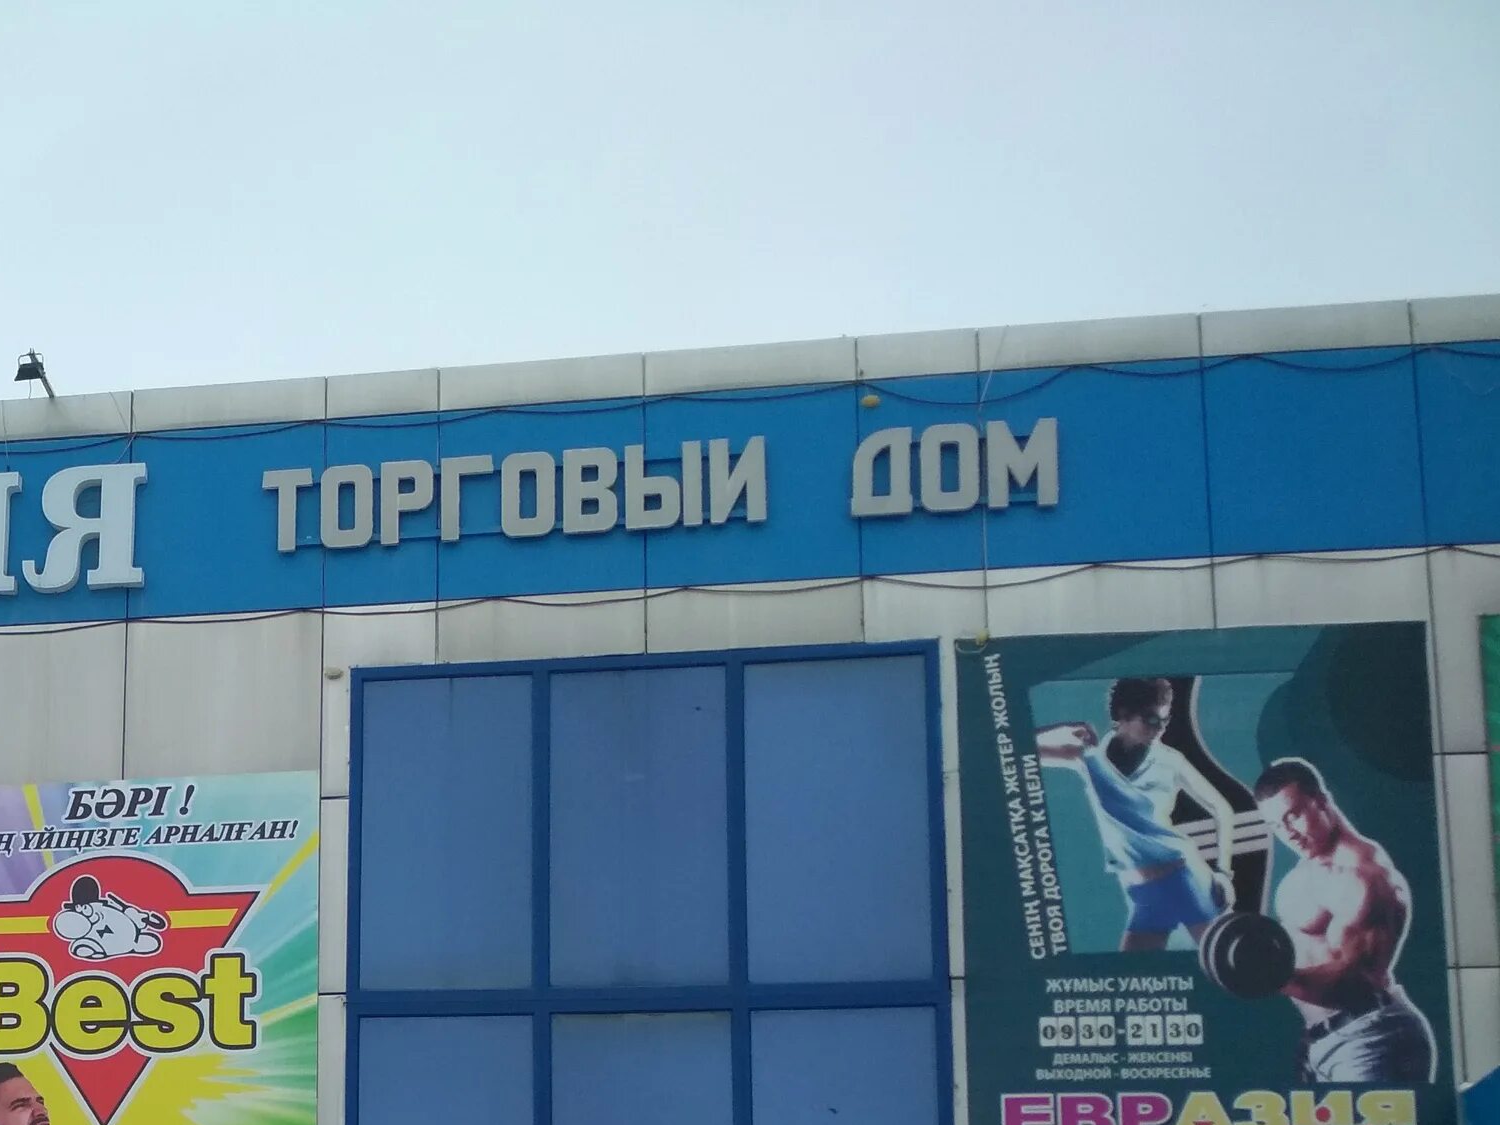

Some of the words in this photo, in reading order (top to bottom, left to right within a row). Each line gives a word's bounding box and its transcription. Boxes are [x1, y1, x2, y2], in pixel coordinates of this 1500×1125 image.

[851, 417, 1060, 518] ДОМ
[984, 653, 1010, 729] ЖОЛЫҢ
[998, 733, 1021, 795] ЖЕТЕР
[1023, 754, 1046, 805] ЦЕЛИ
[21, 827, 140, 853] ҮЙІҢІЗГЕ
[145, 819, 300, 847] АРНАЛҒАН!
[1034, 809, 1046, 821] К
[1008, 799, 1038, 896] МАҚСАТҚА
[1036, 826, 1062, 900] ДОРОГА
[1046, 903, 1068, 955] ТВОЯ
[1053, 999, 1111, 1014] ВРЕМЯ
[1114, 997, 1188, 1013] РАБОТЫ
[1118, 976, 1194, 994] УАҚЫТЫ
[1035, 1066, 1111, 1081] ВЫХОДНОЙ
[1120, 1067, 1211, 1080] ВОСКРЕСЕНЬЕ
[1052, 1052, 1118, 1066] ДЕМАЛЫС
